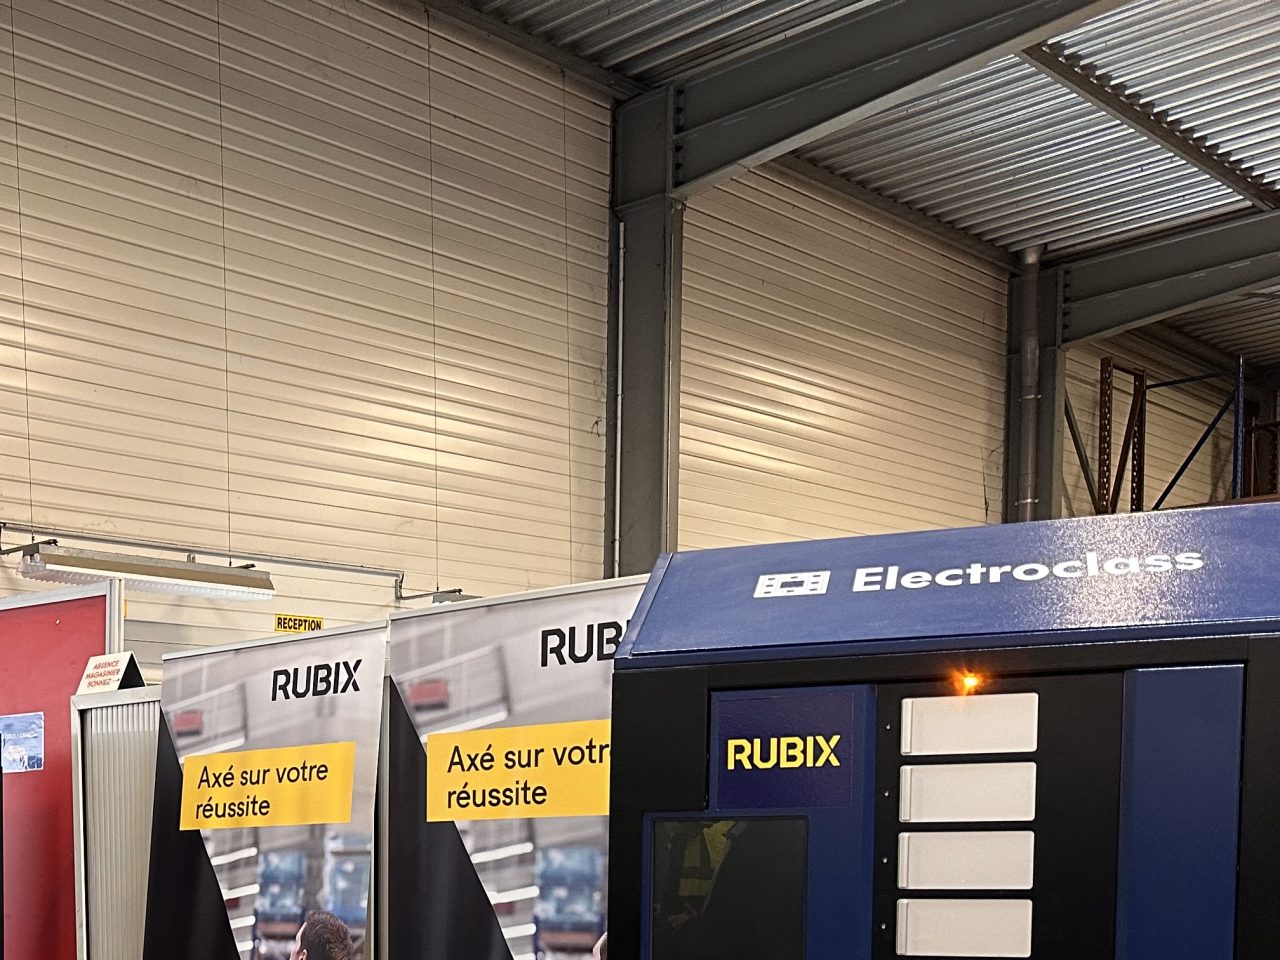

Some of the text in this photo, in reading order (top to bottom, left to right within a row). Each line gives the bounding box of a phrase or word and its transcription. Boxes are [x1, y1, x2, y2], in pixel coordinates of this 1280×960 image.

[852, 551, 1205, 593] Electroclass
[277, 616, 322, 631] RECEPTION
[541, 621, 624, 668] RUB
[271, 659, 363, 702] RUBIX
[447, 737, 610, 773] Axé sur votr
[727, 735, 841, 770] RUBIX
[197, 760, 329, 789] Axé sur votre
[195, 795, 270, 819] réussite
[447, 779, 548, 809] réussite
